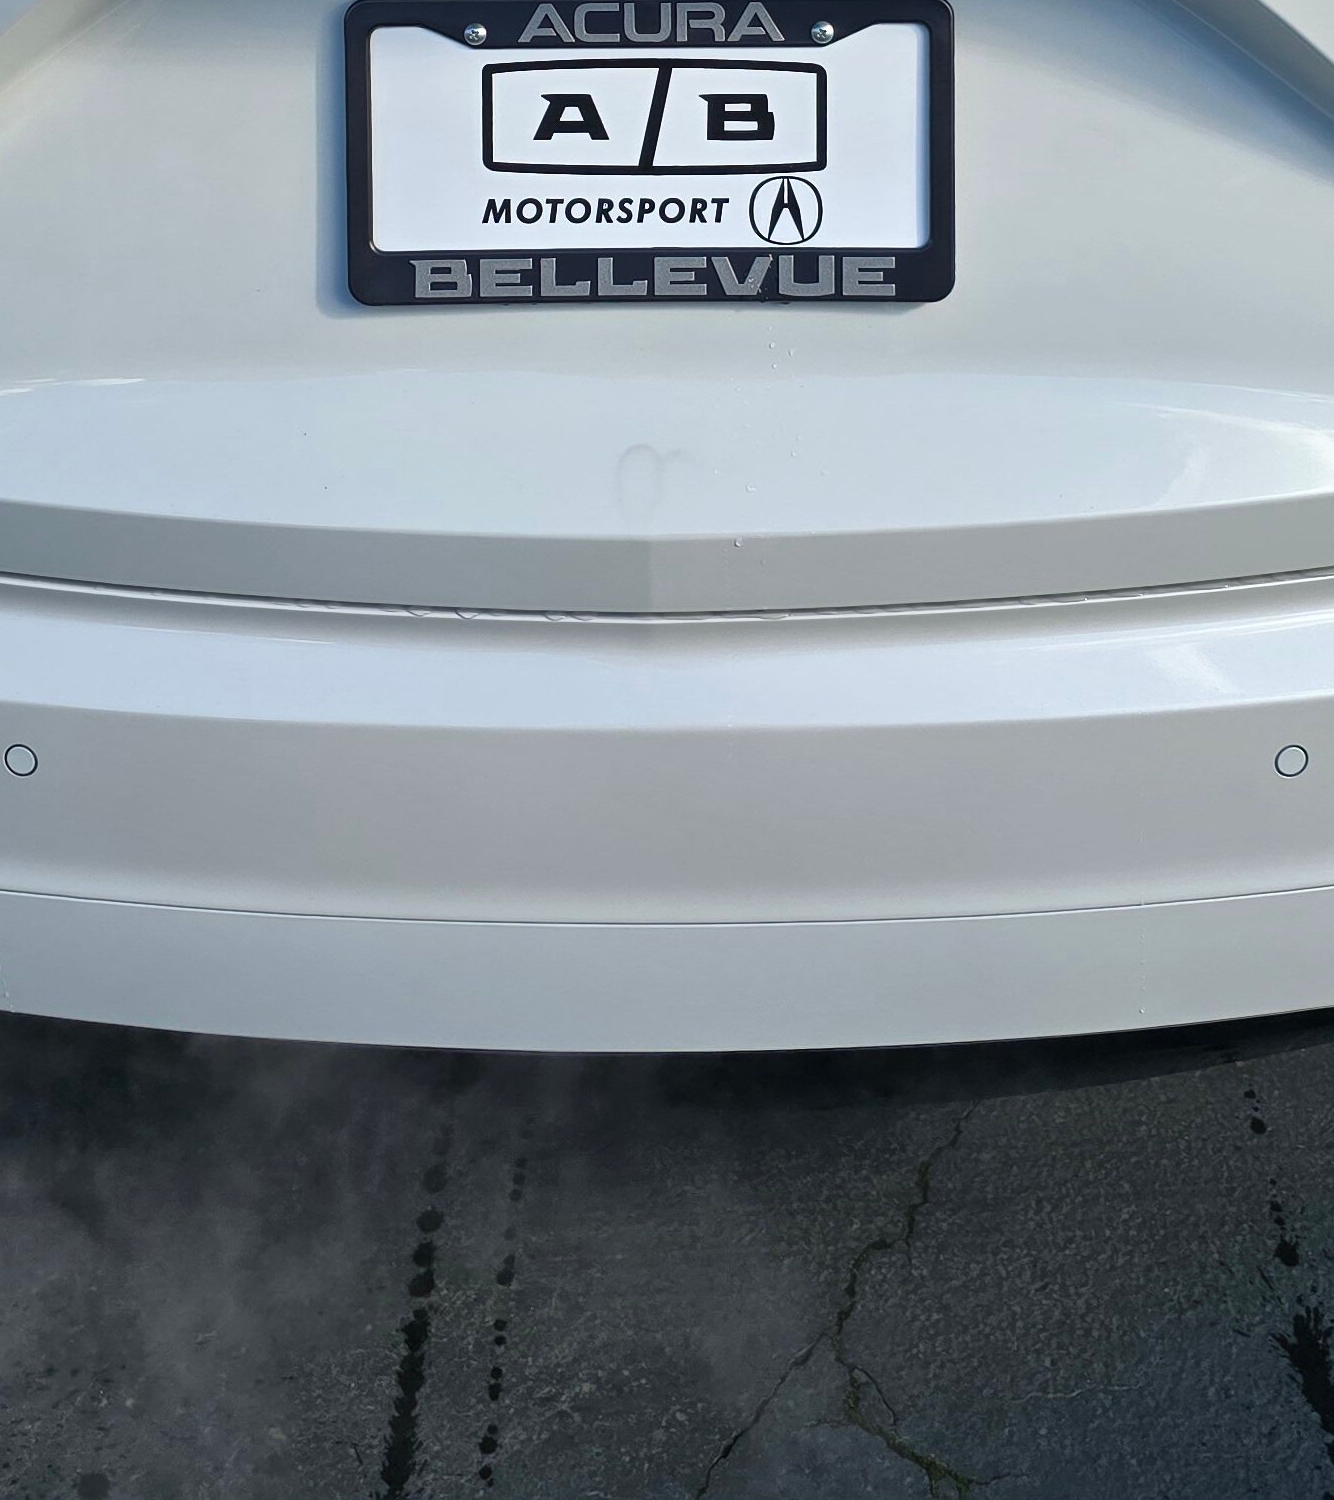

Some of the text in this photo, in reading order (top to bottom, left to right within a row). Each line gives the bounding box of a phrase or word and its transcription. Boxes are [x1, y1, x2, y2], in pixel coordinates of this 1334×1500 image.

[518, 2, 786, 42] ACURA
[481, 197, 730, 224] MOTORSPORT
[408, 255, 897, 298] BELLEVUE
